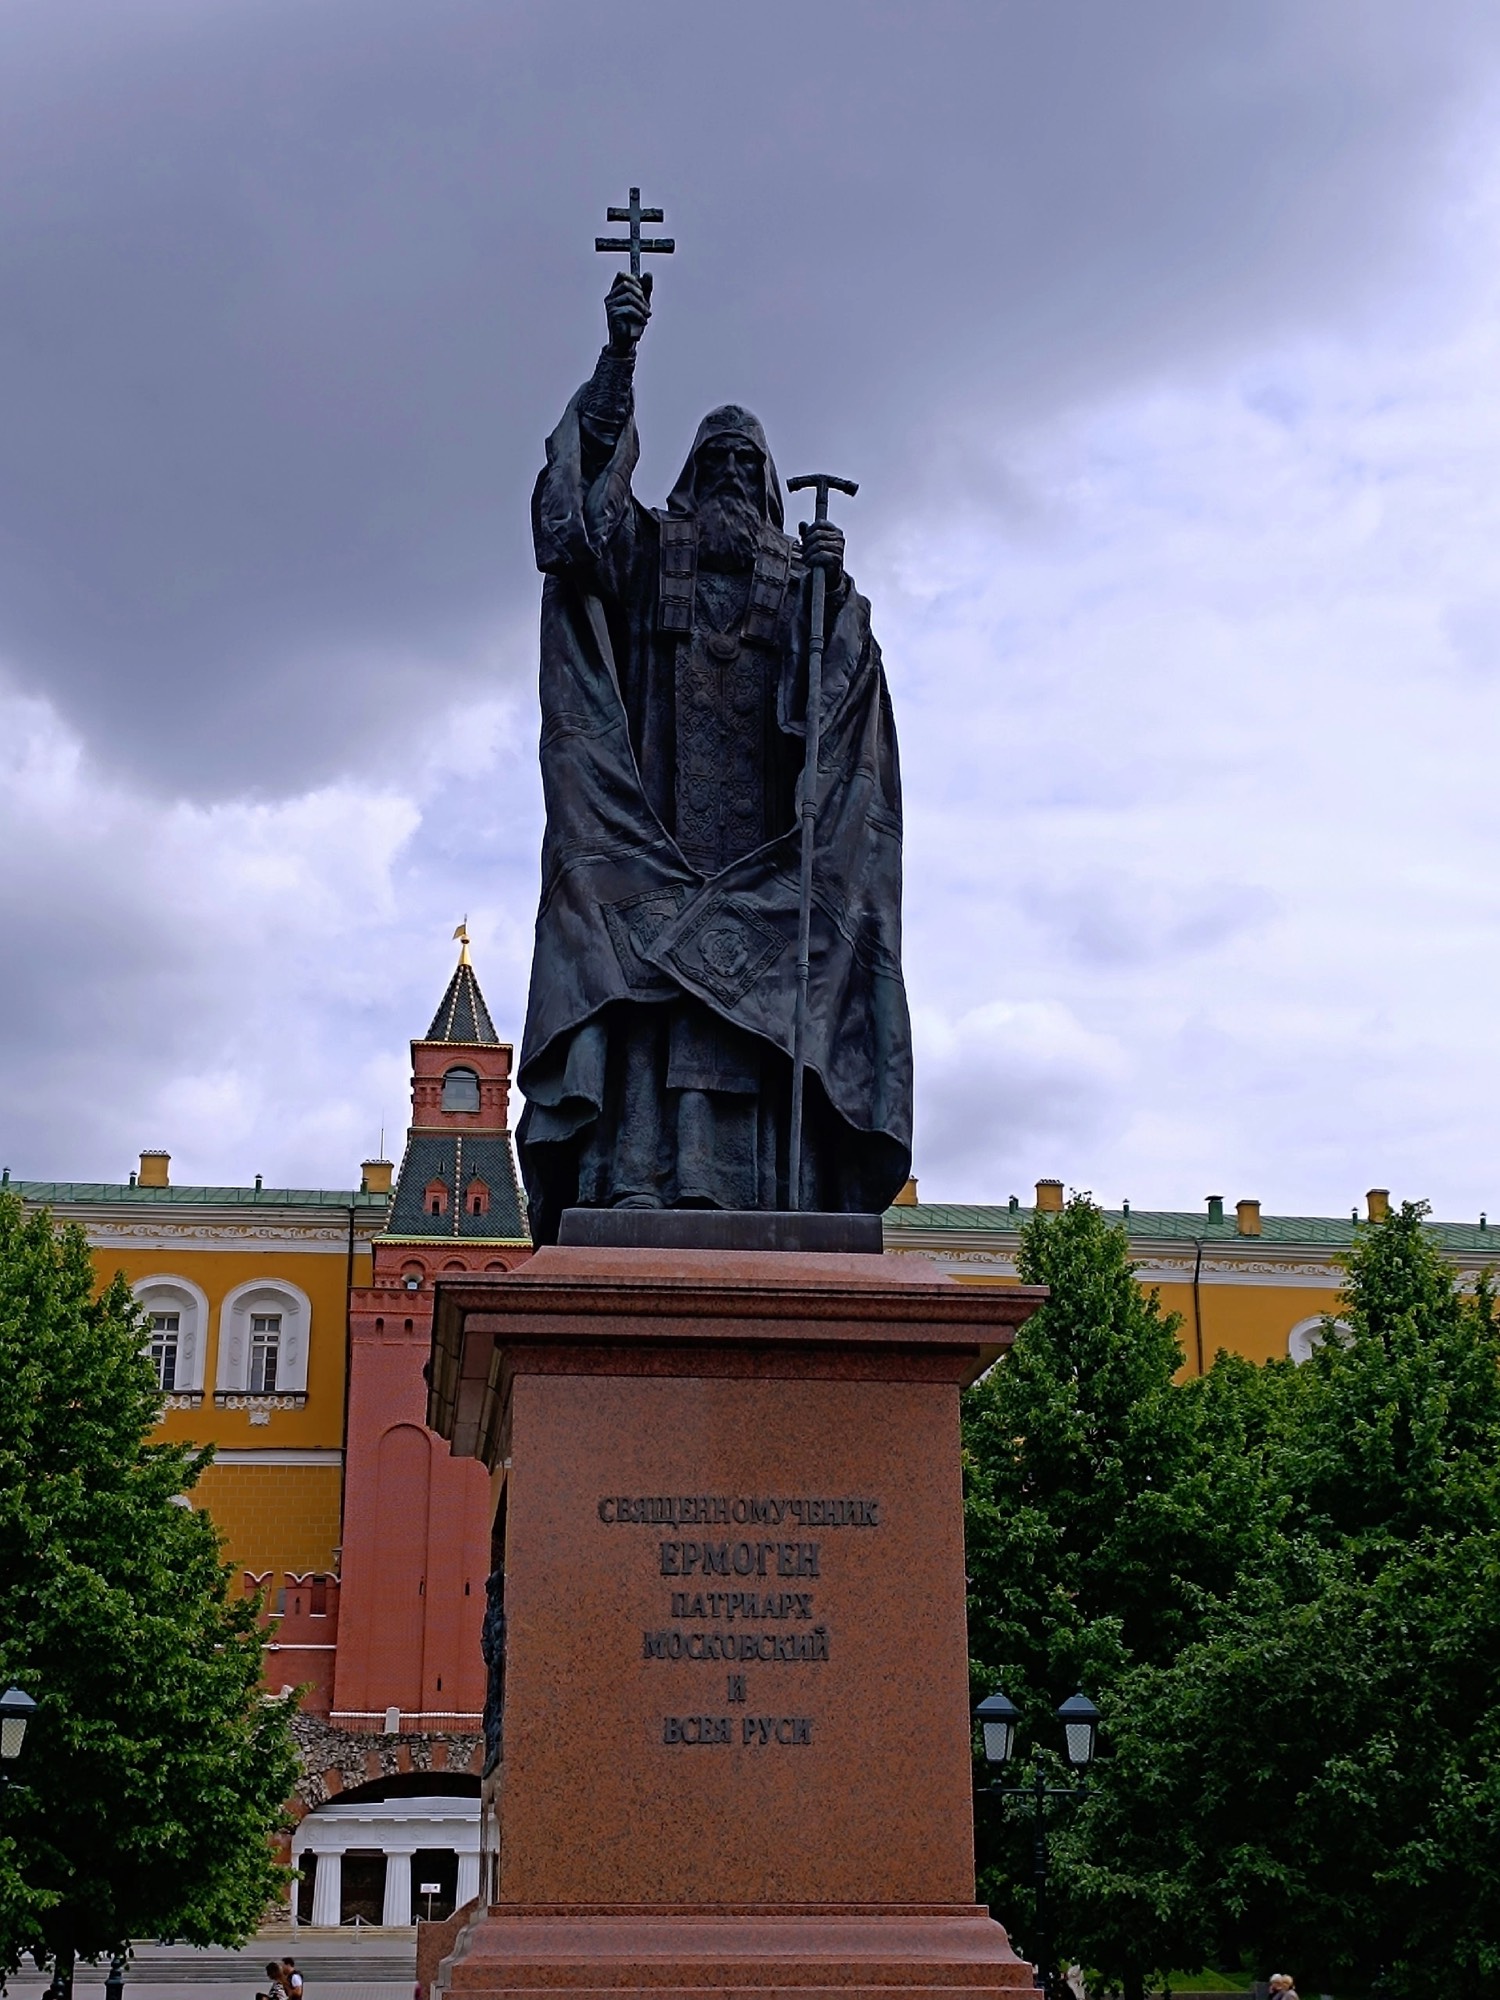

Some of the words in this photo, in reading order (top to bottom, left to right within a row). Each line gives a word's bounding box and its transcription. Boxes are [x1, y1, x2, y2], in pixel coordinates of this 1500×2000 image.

[598, 1496, 879, 1529] СВЯЩЕННОМУЧЕНИК
[660, 1542, 820, 1575] ЕРМОГЕН
[671, 1592, 813, 1618] ПАТРИАРХ
[643, 1627, 830, 1661] МОСКОВСКИЙ
[727, 1674, 746, 1702] И
[664, 1717, 732, 1744] ВСЕЯ
[742, 1717, 813, 1745] РУСИ
